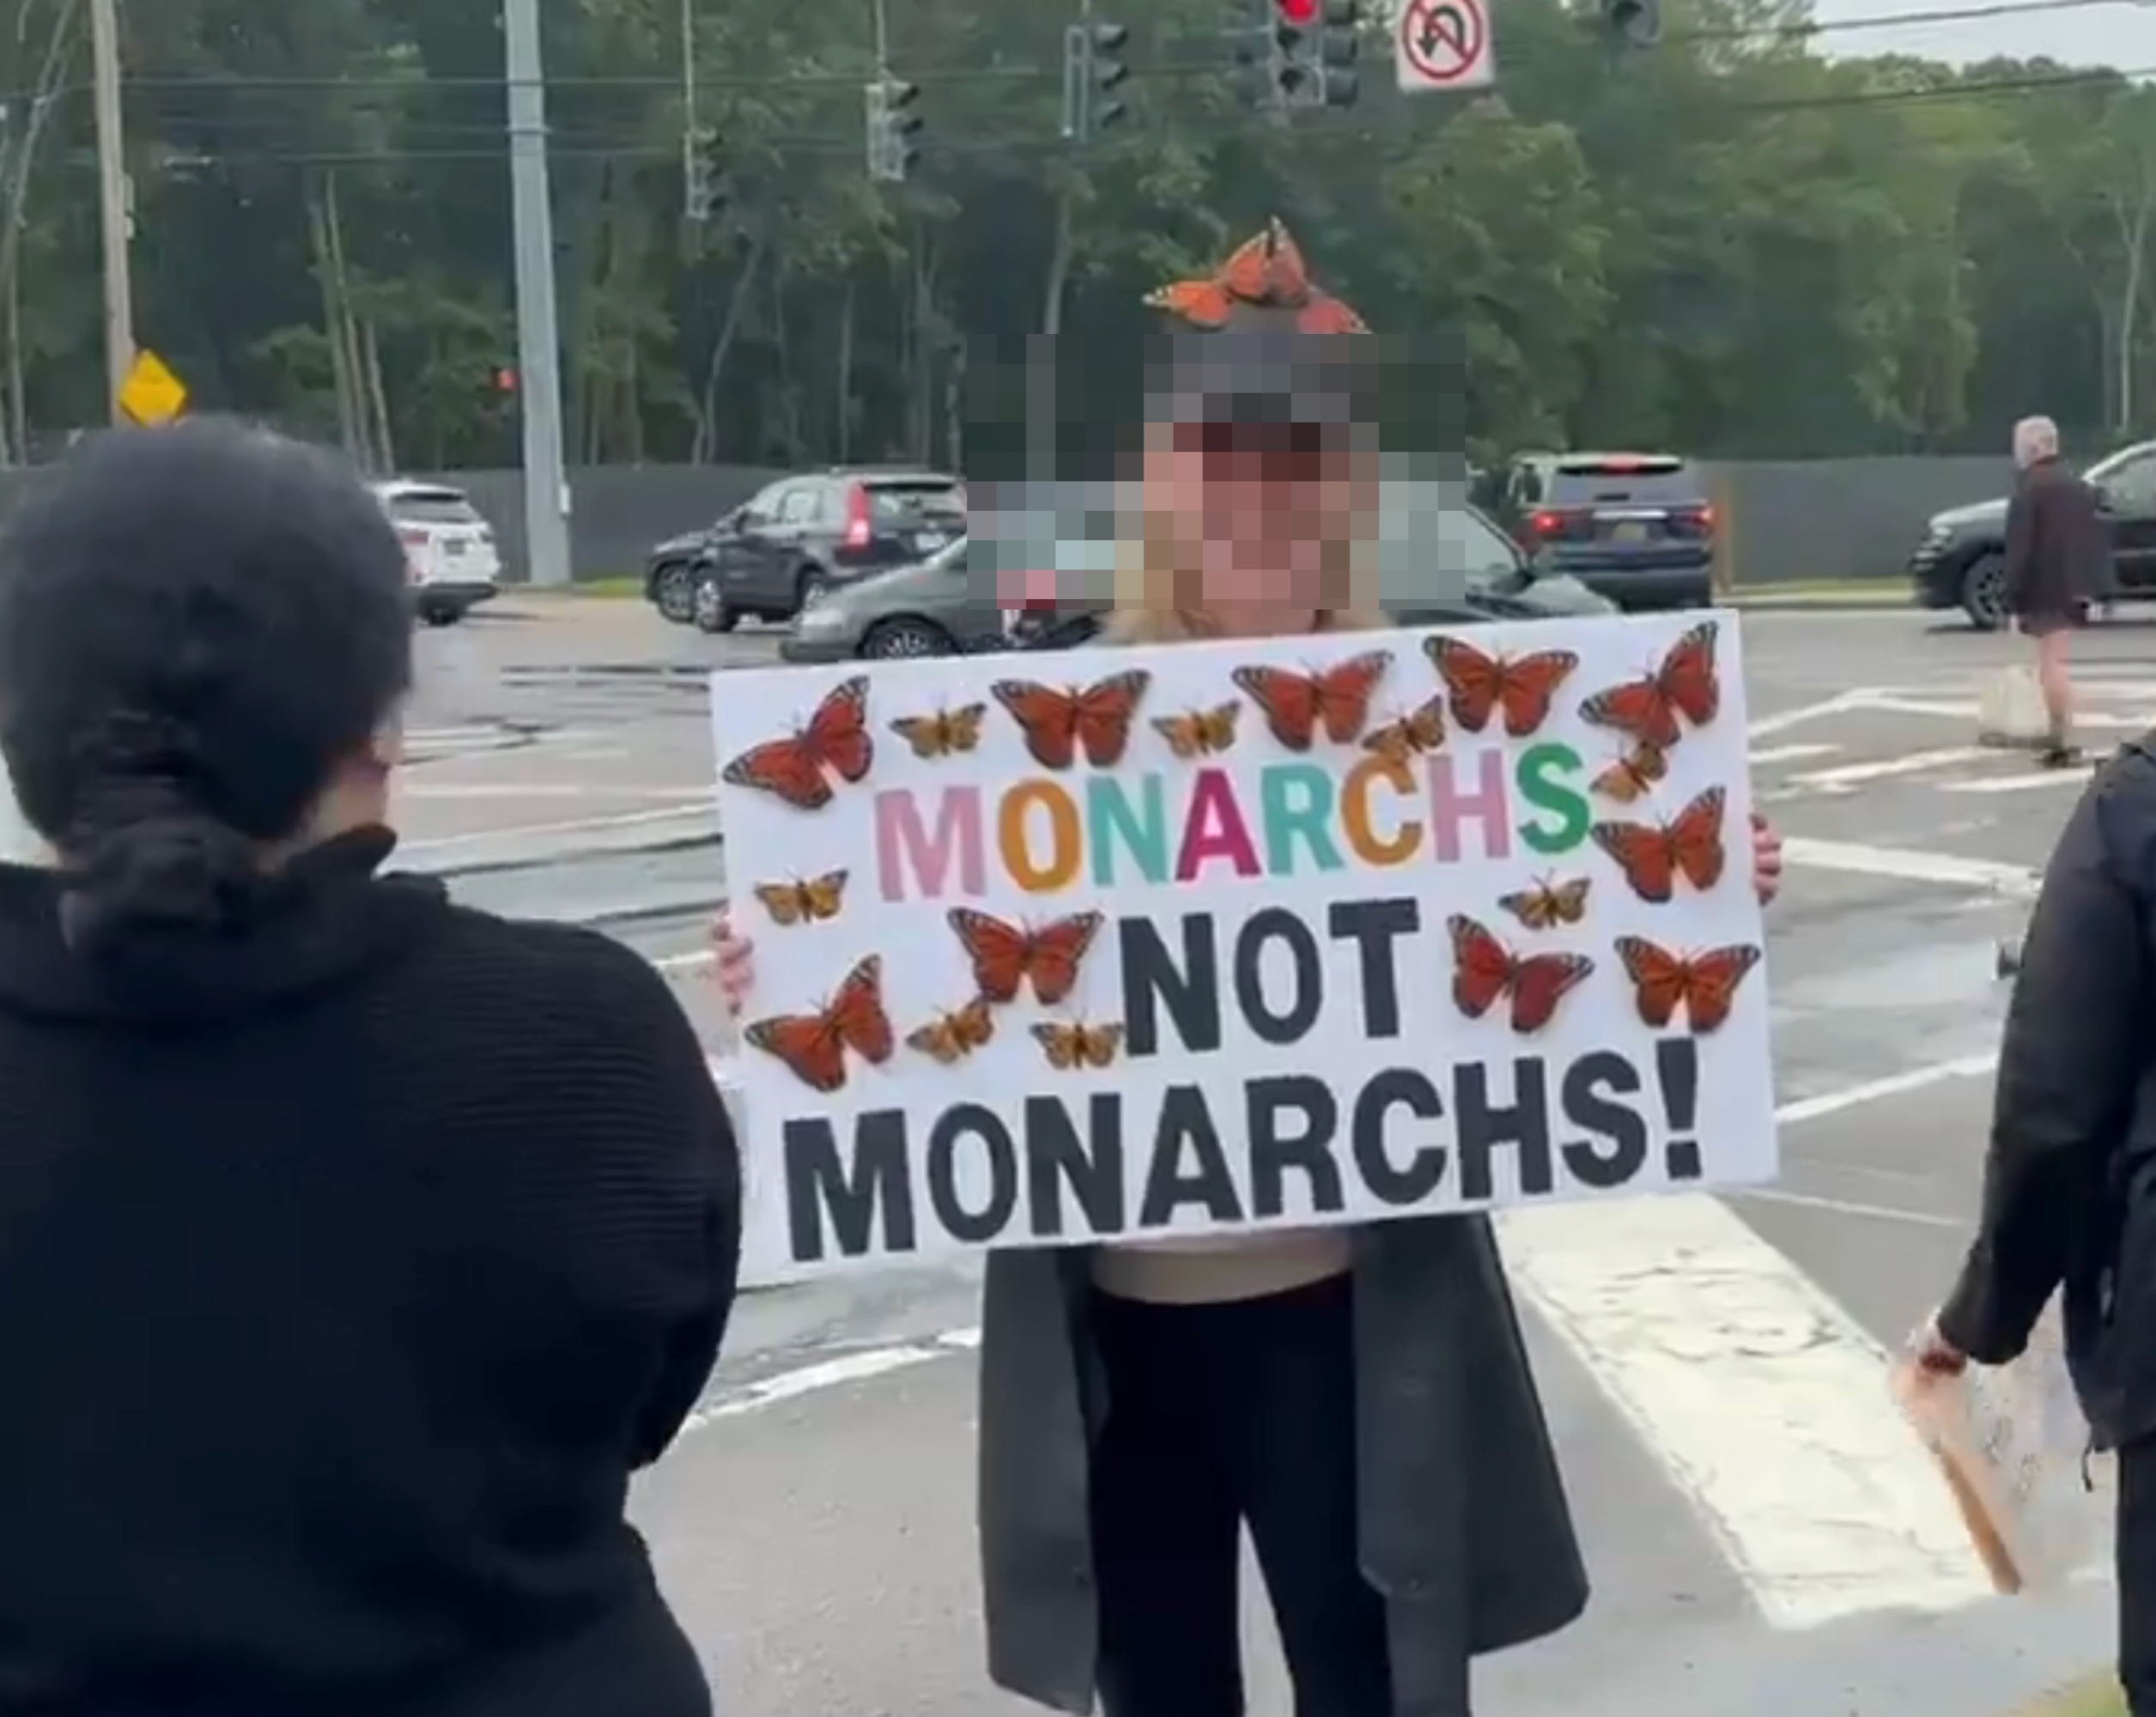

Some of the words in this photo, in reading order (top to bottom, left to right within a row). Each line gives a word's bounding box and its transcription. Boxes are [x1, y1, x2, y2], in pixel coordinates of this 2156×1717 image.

[875, 742, 1591, 901] MONARCHS
[1120, 897, 1419, 1059] NOT
[783, 1036, 1703, 1262] MONARCHS!
